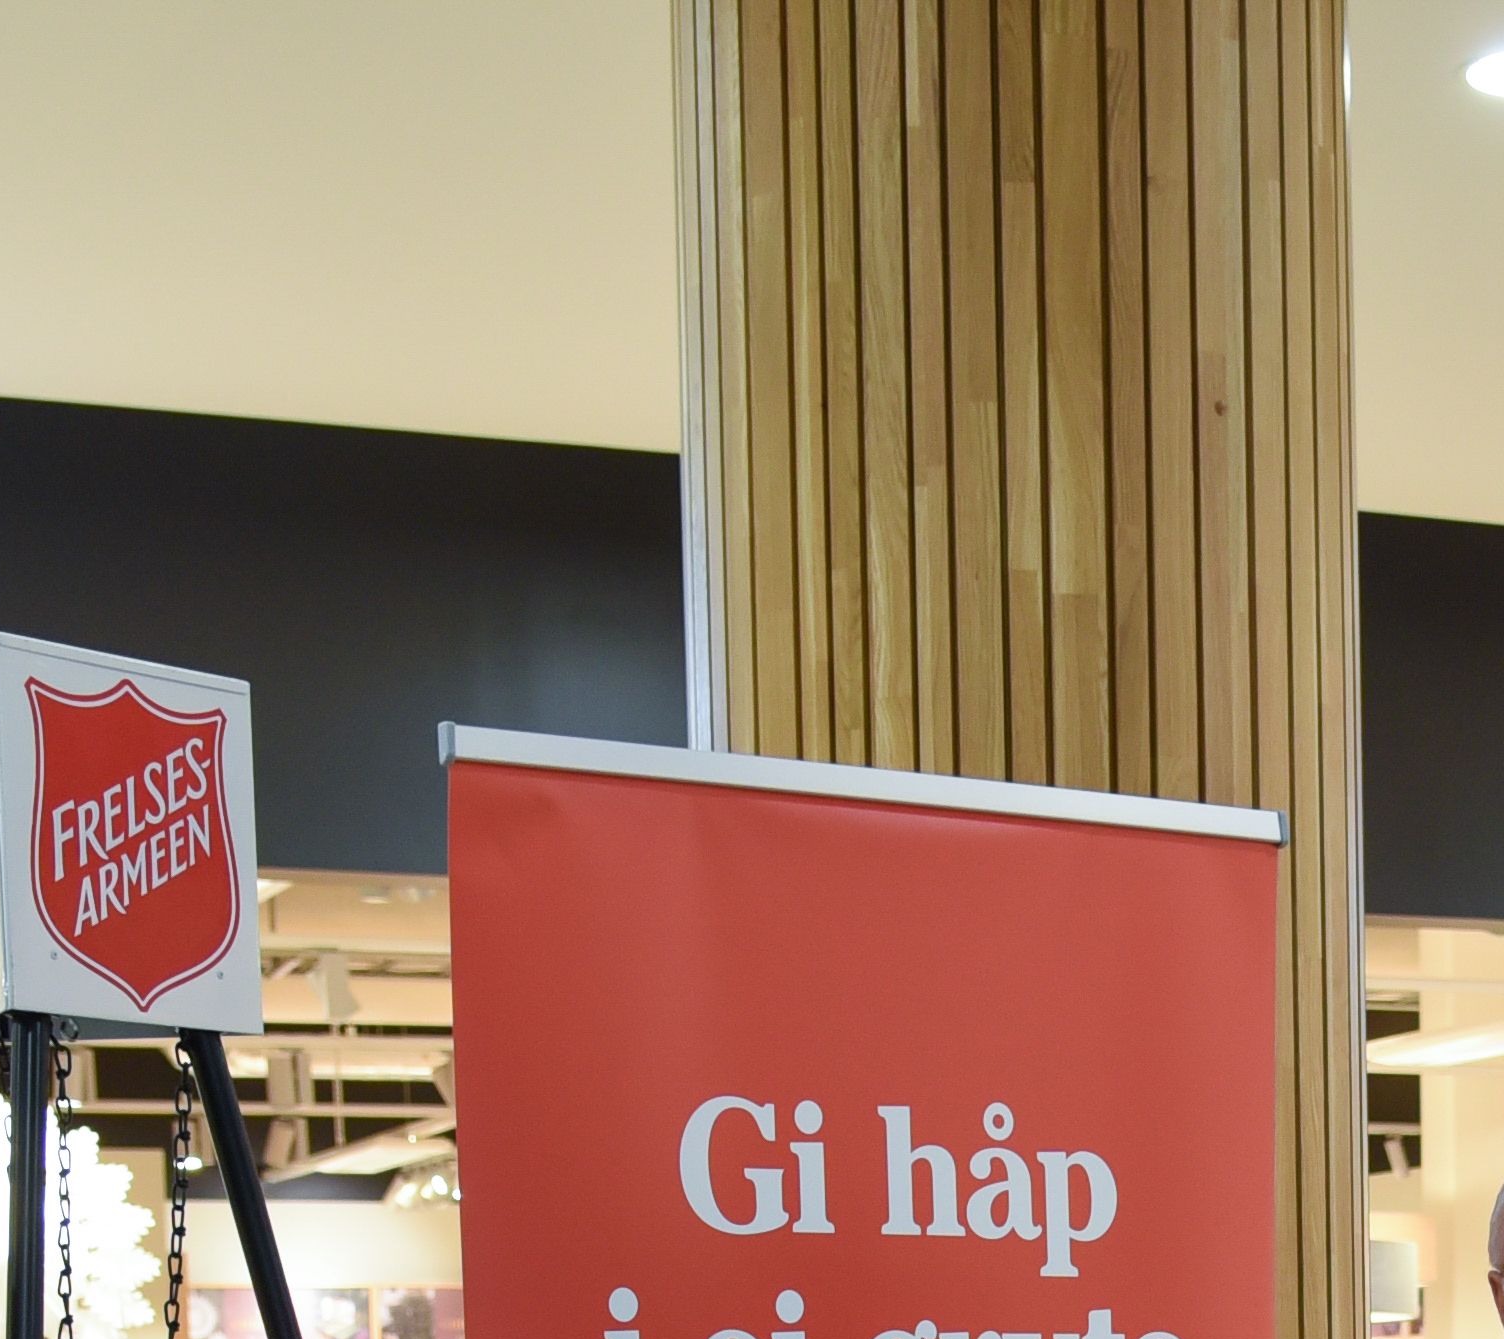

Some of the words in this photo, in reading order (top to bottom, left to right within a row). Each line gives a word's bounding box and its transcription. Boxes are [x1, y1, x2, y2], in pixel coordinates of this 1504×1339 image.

[52, 737, 210, 881] FRELSES-
[74, 805, 212, 936] ARMEEN
[679, 1095, 836, 1236] Gi
[877, 1101, 1118, 1278] håp
